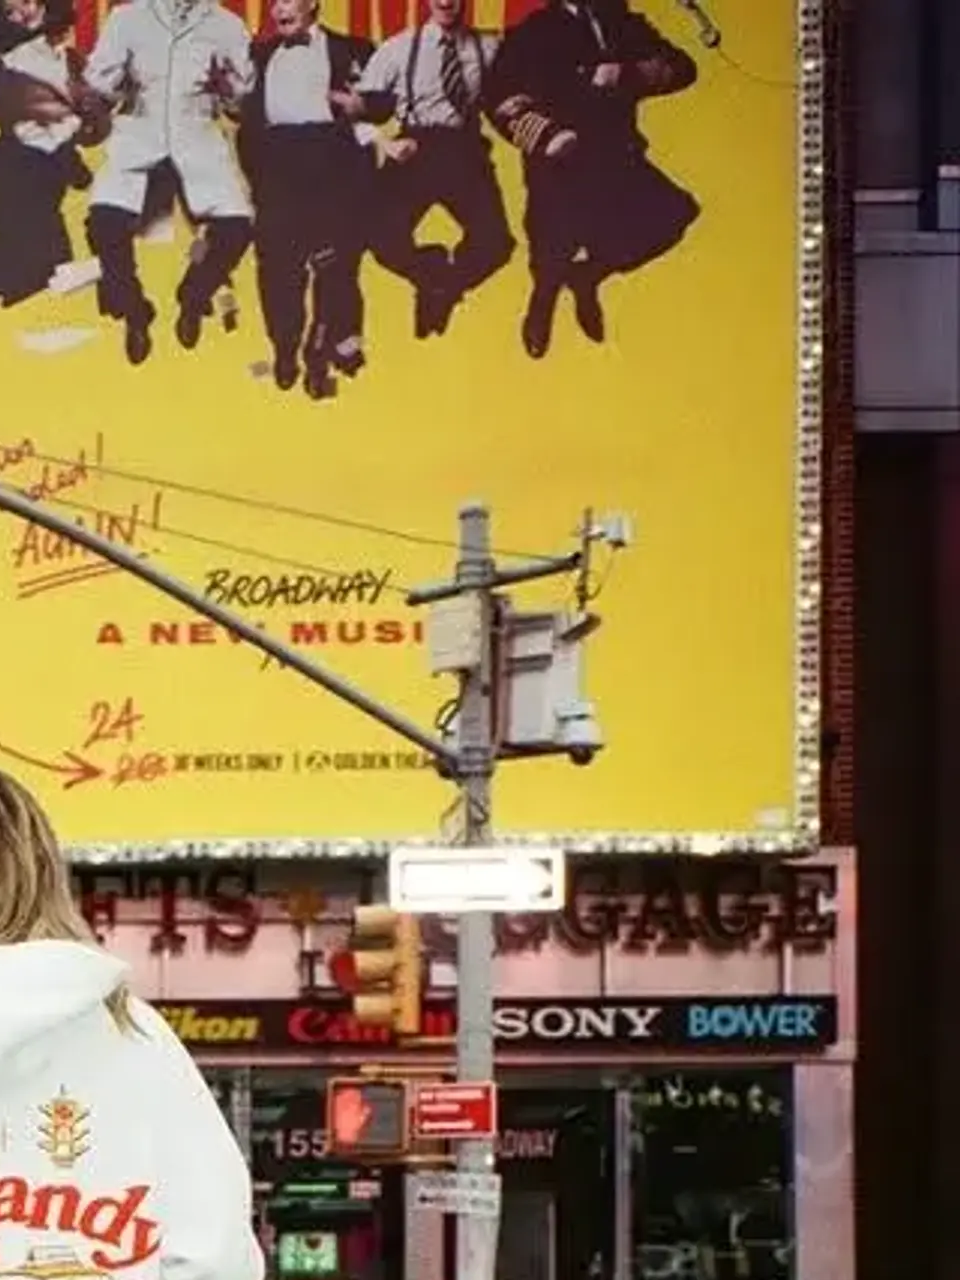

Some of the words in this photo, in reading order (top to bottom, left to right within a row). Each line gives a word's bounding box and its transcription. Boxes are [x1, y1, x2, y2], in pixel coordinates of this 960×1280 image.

[204, 569, 392, 608] BROADWAY
[97, 622, 124, 645] A
[290, 621, 424, 644] MUSI
[158, 1005, 261, 1041] ikon
[287, 1008, 456, 1043] Cann
[492, 1006, 662, 1038] SONY
[688, 1005, 817, 1036] BOWER
